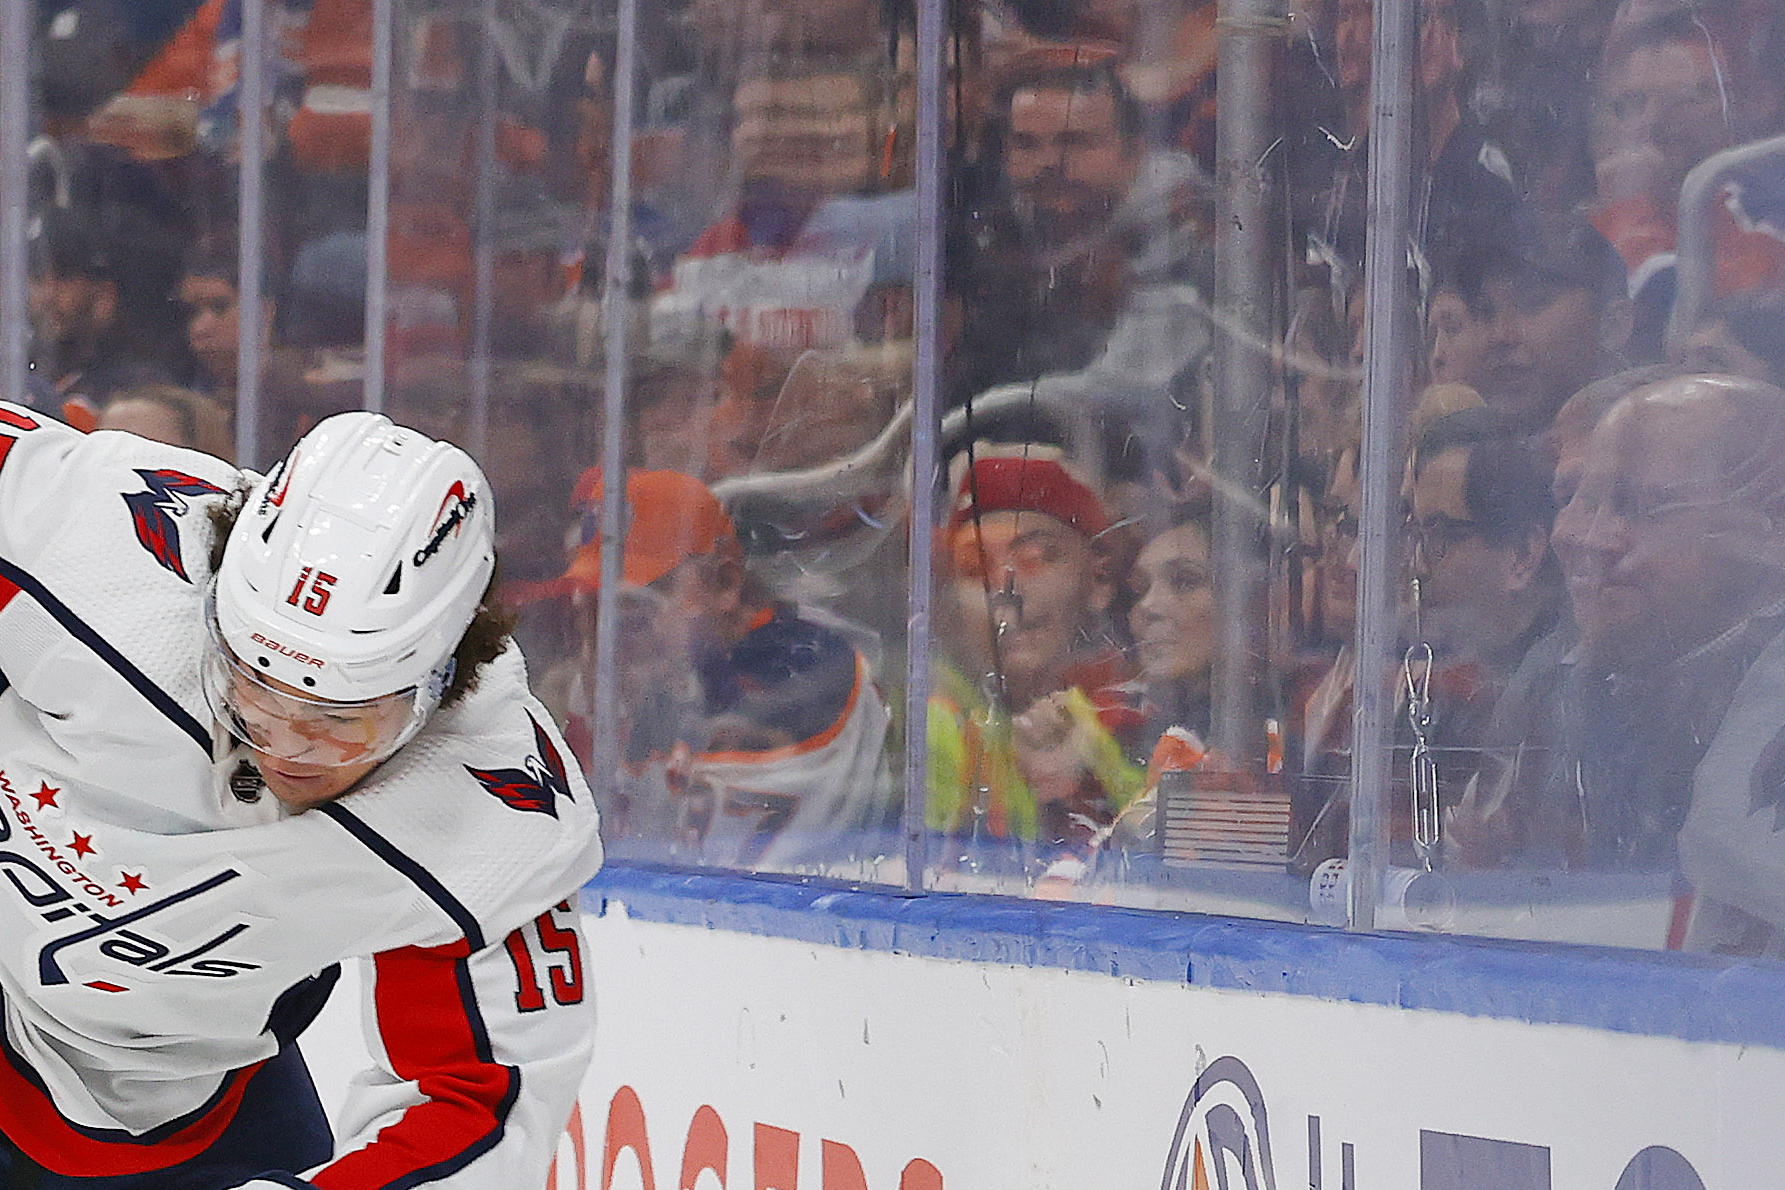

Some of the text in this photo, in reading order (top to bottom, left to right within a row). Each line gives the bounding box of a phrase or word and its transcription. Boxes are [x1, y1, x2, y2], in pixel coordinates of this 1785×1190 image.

[285, 565, 339, 618] 15
[250, 632, 326, 669] BAUER
[502, 898, 584, 1013] 15
